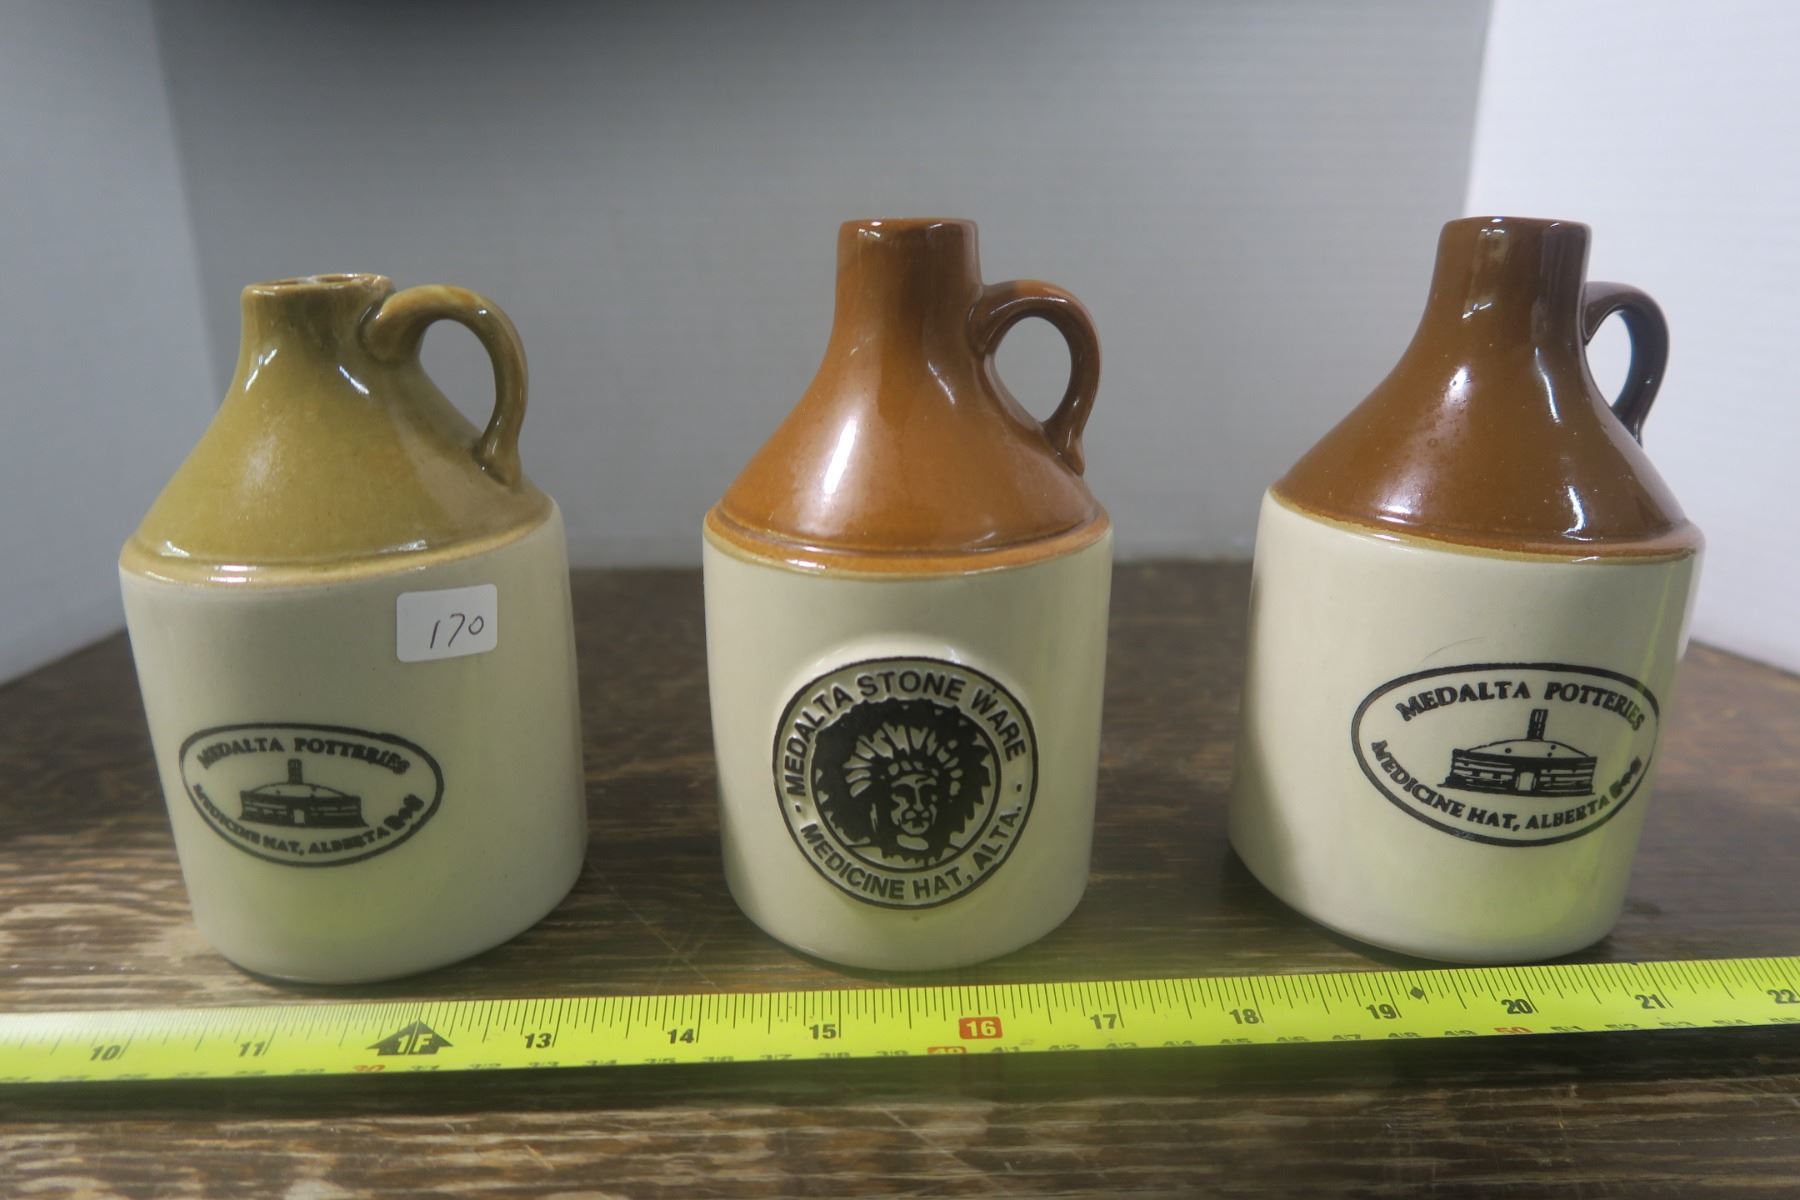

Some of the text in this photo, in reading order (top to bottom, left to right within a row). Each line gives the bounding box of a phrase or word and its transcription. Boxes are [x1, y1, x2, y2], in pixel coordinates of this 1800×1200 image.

[429, 612, 485, 650] 170
[783, 669, 1027, 797] MEDALTA STONE WARE
[1395, 681, 1645, 731] MEDALTA POTTERIES
[1371, 739, 1610, 832] MEDICINE HAT, ALBERTA
[800, 805, 1023, 899] MEDICINE HAT, ALTA.
[89, 1044, 121, 1061] 10
[238, 1040, 266, 1057] 11
[523, 1032, 553, 1049] 13
[666, 1028, 695, 1044] 14
[808, 1023, 838, 1040] 15
[965, 1020, 998, 1038] 16
[1089, 1013, 1118, 1030] 17
[1228, 1008, 1260, 1025] 18
[1366, 1003, 1397, 1020] 19
[1500, 998, 1534, 1015] 20
[1634, 993, 1667, 1010] 21
[1766, 988, 1800, 1005] 22
